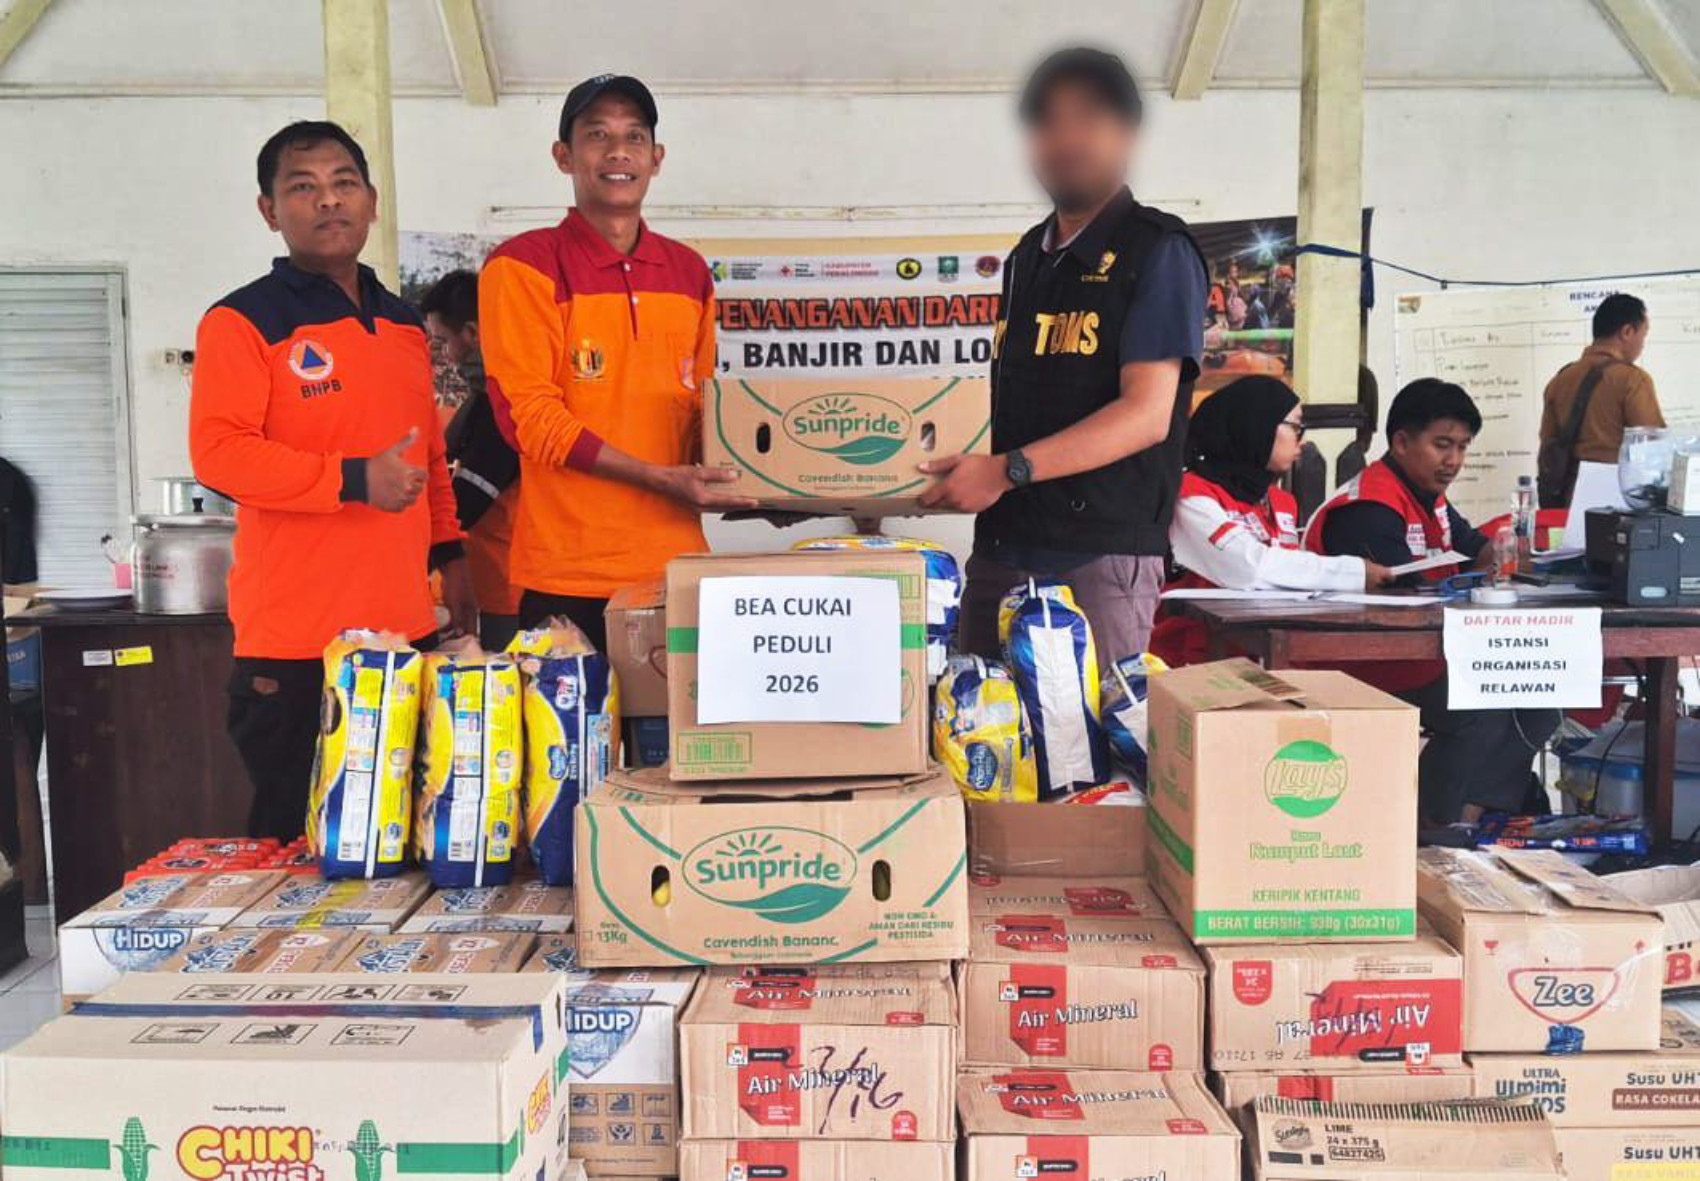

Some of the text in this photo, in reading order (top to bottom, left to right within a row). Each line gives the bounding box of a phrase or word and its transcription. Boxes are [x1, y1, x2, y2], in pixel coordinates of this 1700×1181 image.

[744, 342, 863, 368] BANJIR
[877, 340, 940, 365] DAN
[301, 379, 342, 399] BNPB
[793, 413, 901, 439] Sunpride
[734, 598, 851, 616] BEA CUKAI
[1464, 615, 1521, 626] DAFTAR
[753, 635, 832, 654] PEDULI
[1488, 638, 1549, 648] ISTANSI
[1472, 660, 1567, 671] ORGANISASI
[766, 675, 819, 693] 2026
[1480, 683, 1555, 693] RELAWAN
[695, 853, 842, 889] Sunpride
[1208, 916, 1249, 930] BERAT
[117, 928, 184, 949] HIDUP
[704, 936, 778, 947] Cavendish
[1534, 976, 1594, 1007] Zee
[1017, 998, 1138, 1028] Air Mineral
[1276, 1004, 1430, 1045] Air Mineral
[748, 1062, 879, 1095] Air Mineral
[1523, 1068, 1560, 1078] ULTRA
[1627, 1072, 1666, 1085] Susu
[176, 1125, 314, 1181] CHIKI
[1624, 1147, 1663, 1159] Susu
